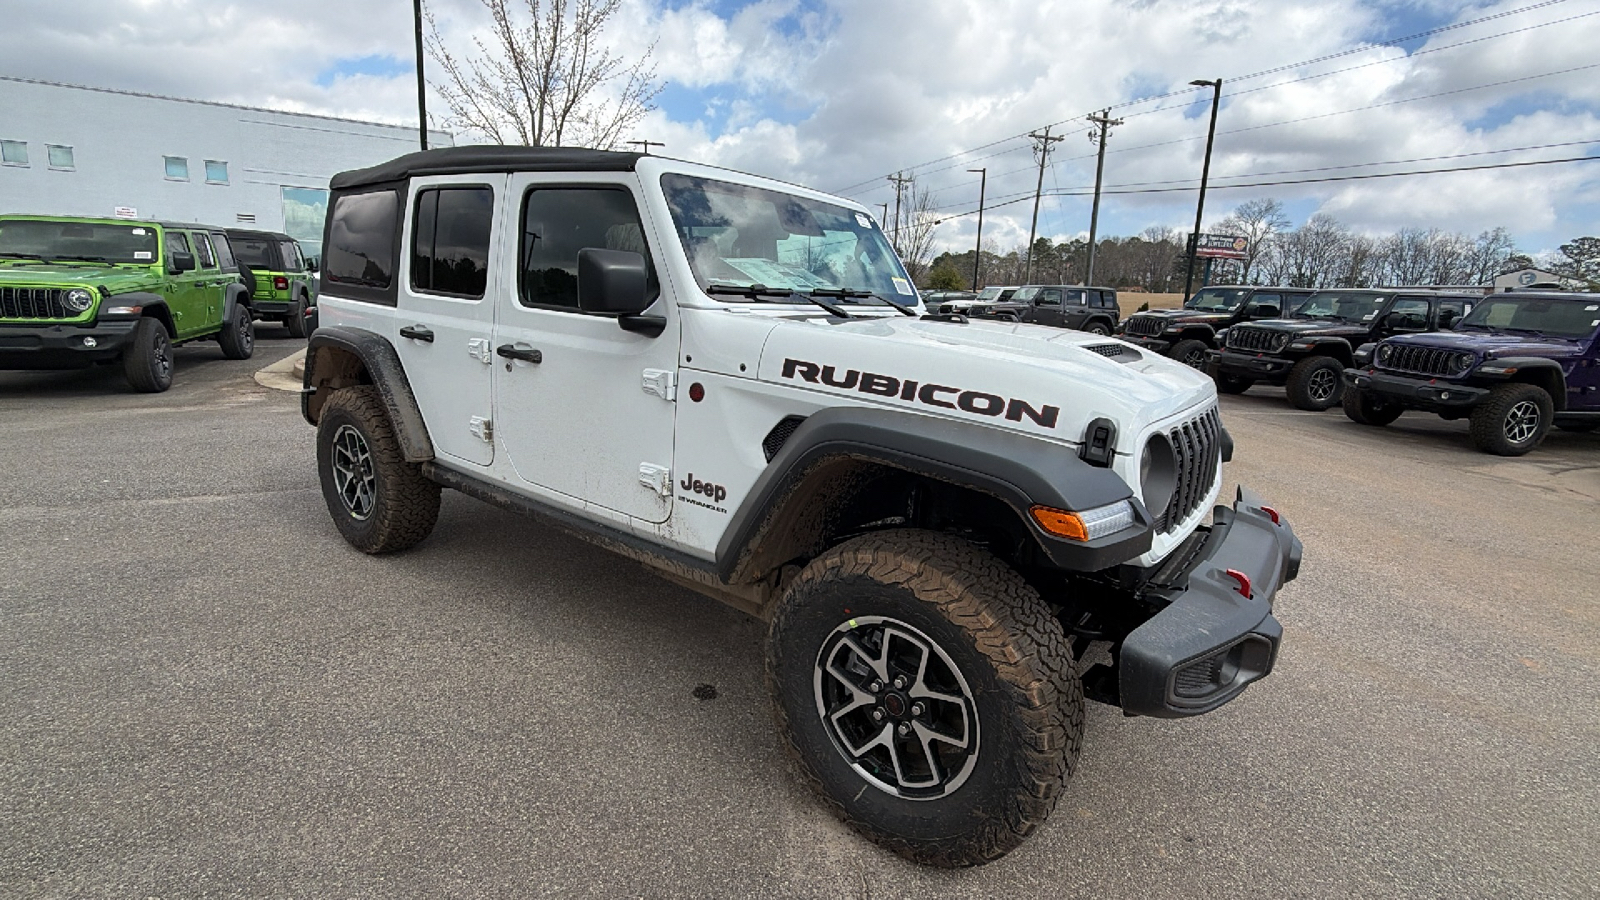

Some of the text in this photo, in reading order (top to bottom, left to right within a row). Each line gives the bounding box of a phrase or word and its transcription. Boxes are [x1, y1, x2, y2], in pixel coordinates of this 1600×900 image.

[781, 358, 1060, 429] RUBICON
[680, 472, 727, 503] Jeep
[685, 497, 728, 514] WRANGLER
